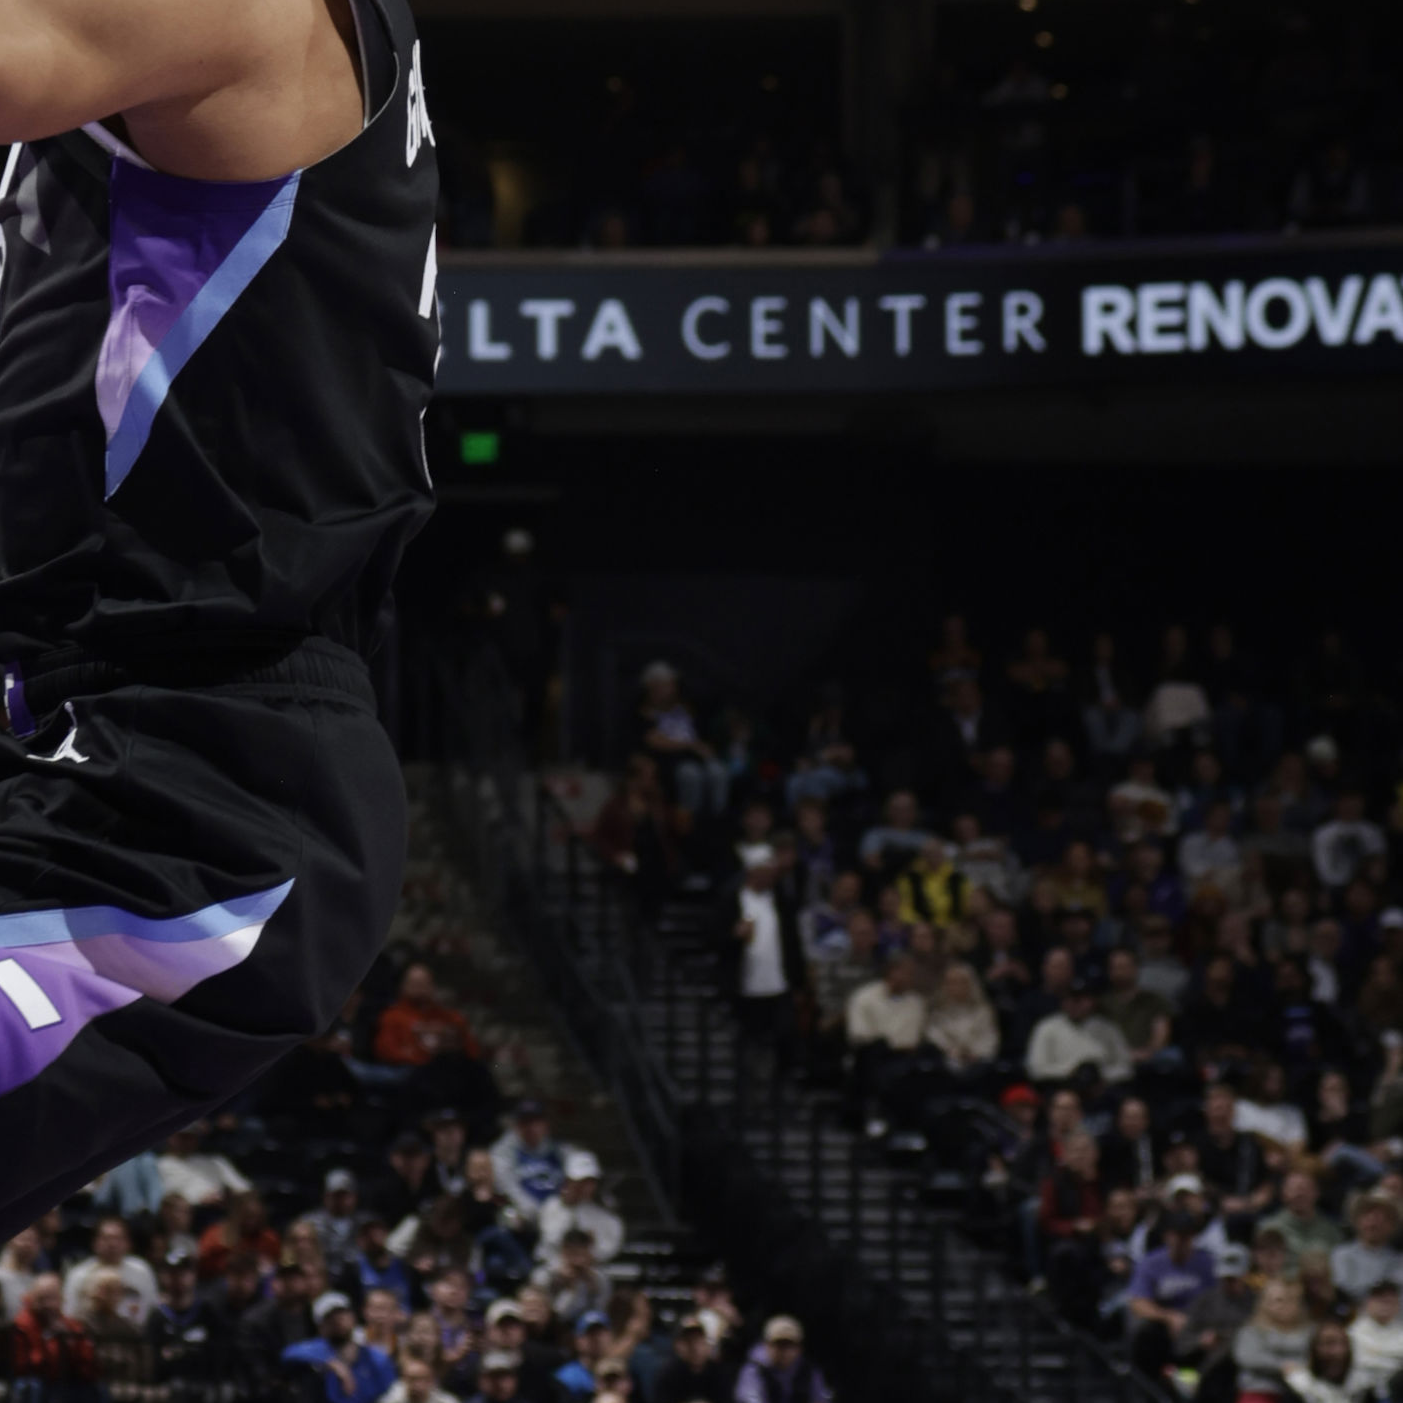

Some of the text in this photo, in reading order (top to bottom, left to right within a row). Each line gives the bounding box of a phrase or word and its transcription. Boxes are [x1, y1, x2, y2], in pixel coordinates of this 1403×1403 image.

[438, 298, 644, 362] LTA
[680, 290, 1047, 362] CENTER
[1080, 272, 1403, 357] RENOVA
